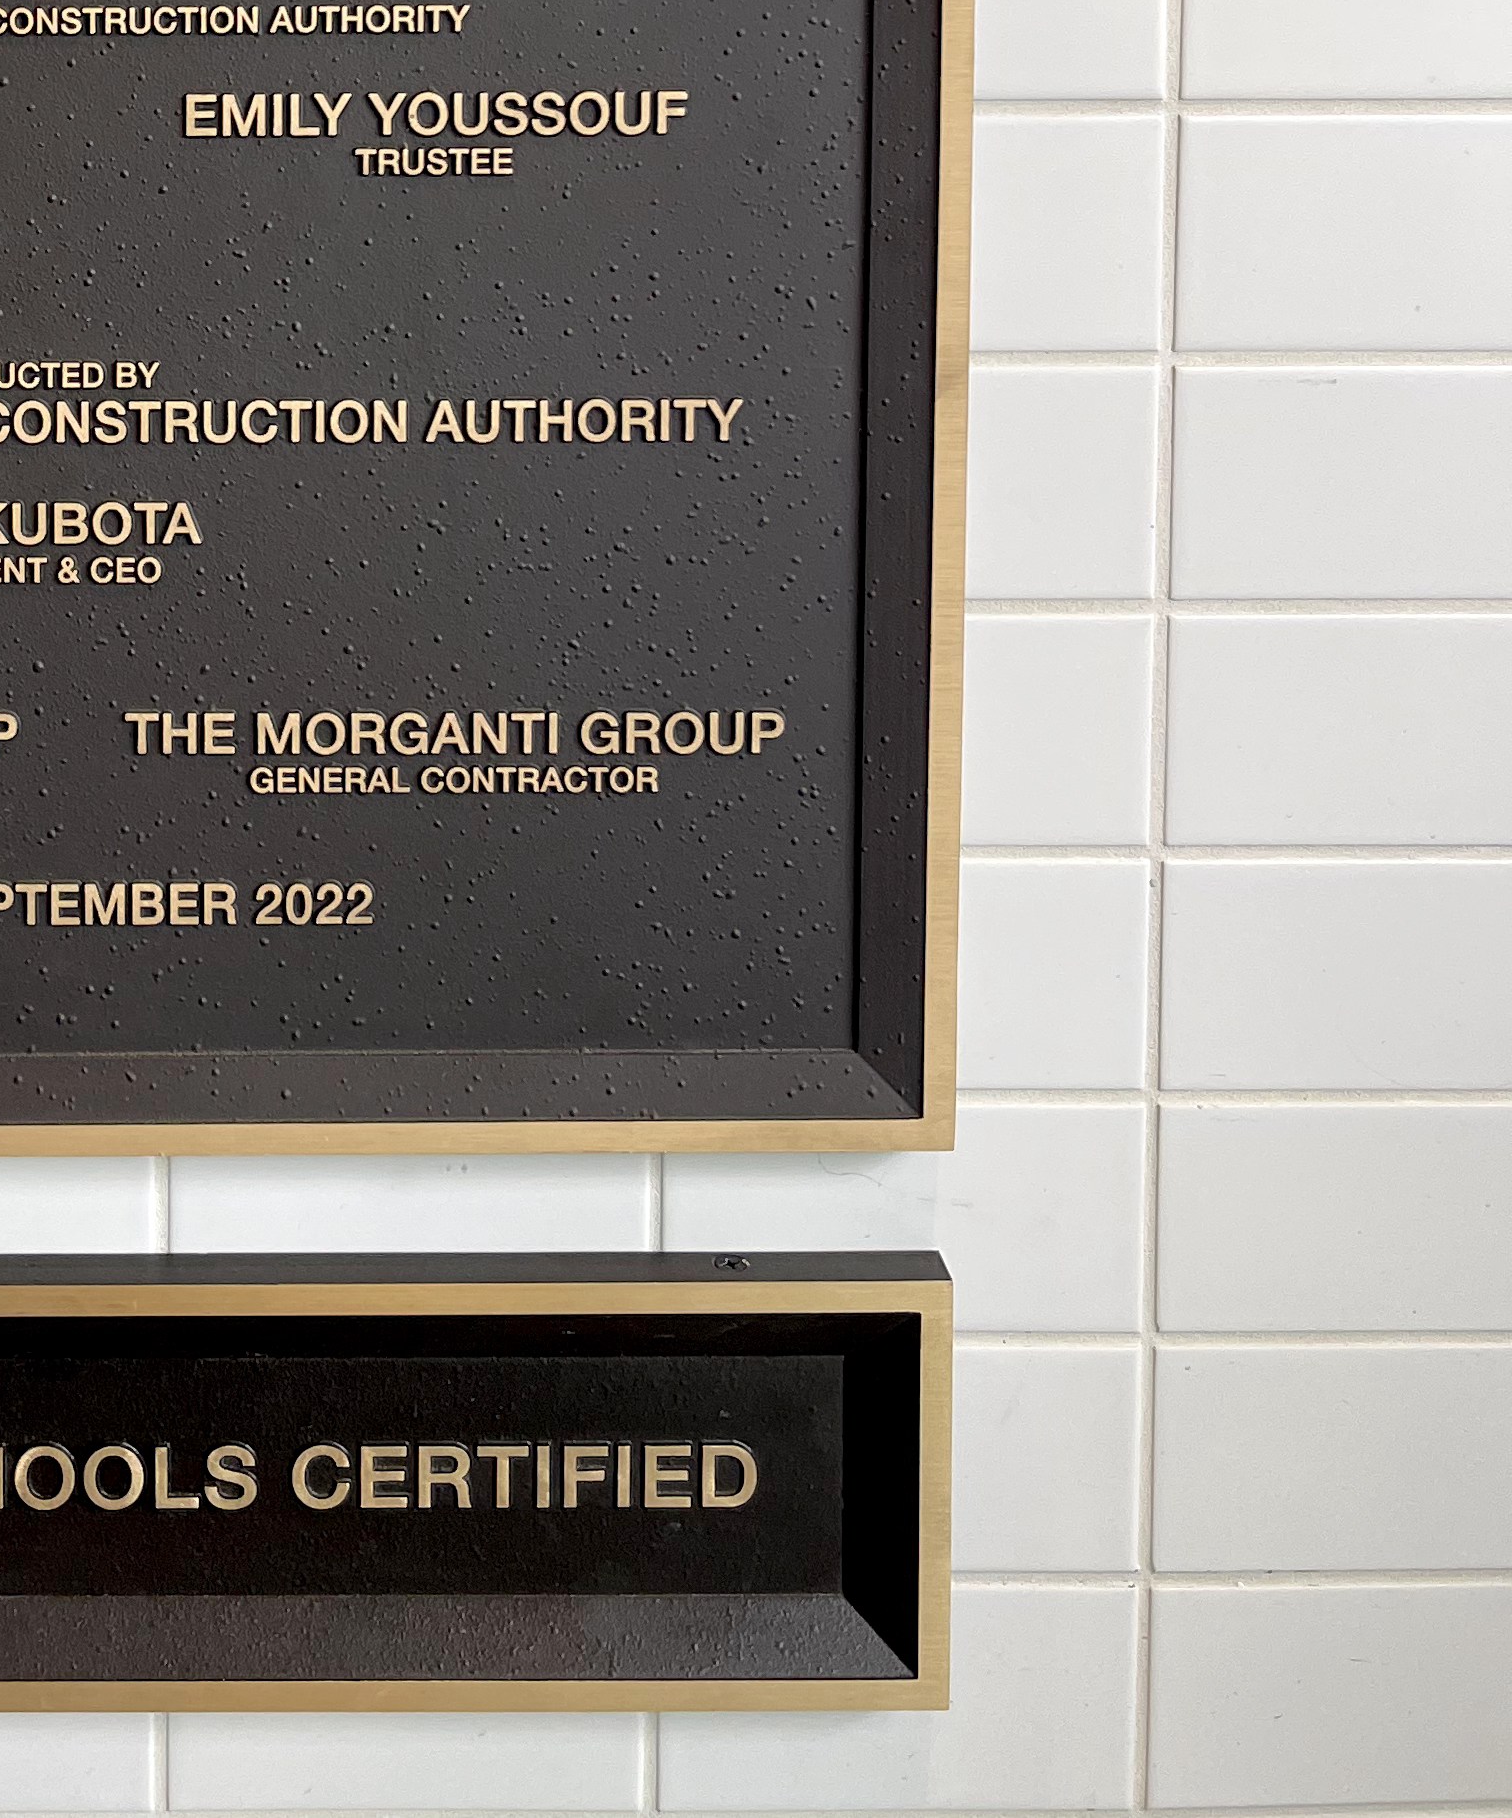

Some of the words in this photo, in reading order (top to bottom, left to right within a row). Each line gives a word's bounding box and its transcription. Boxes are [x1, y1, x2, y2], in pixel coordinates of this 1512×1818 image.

[269, 4, 471, 34] AUTHORITY
[185, 92, 353, 137] EMILY
[368, 90, 689, 136] YOUSSOUF
[354, 147, 514, 176] TRUSTEE
[116, 361, 160, 389] BY
[425, 398, 744, 444] AUTHORITY
[57, 556, 81, 584] &
[90, 556, 162, 584] CEO
[124, 712, 236, 755] THE
[256, 711, 559, 756] MORGANTI
[580, 711, 785, 755] GROUP
[250, 766, 411, 794] GENERAL
[420, 766, 659, 794] CONTRACTOR
[255, 882, 373, 925] 2022
[291, 1439, 758, 1510] CERTIFIED
